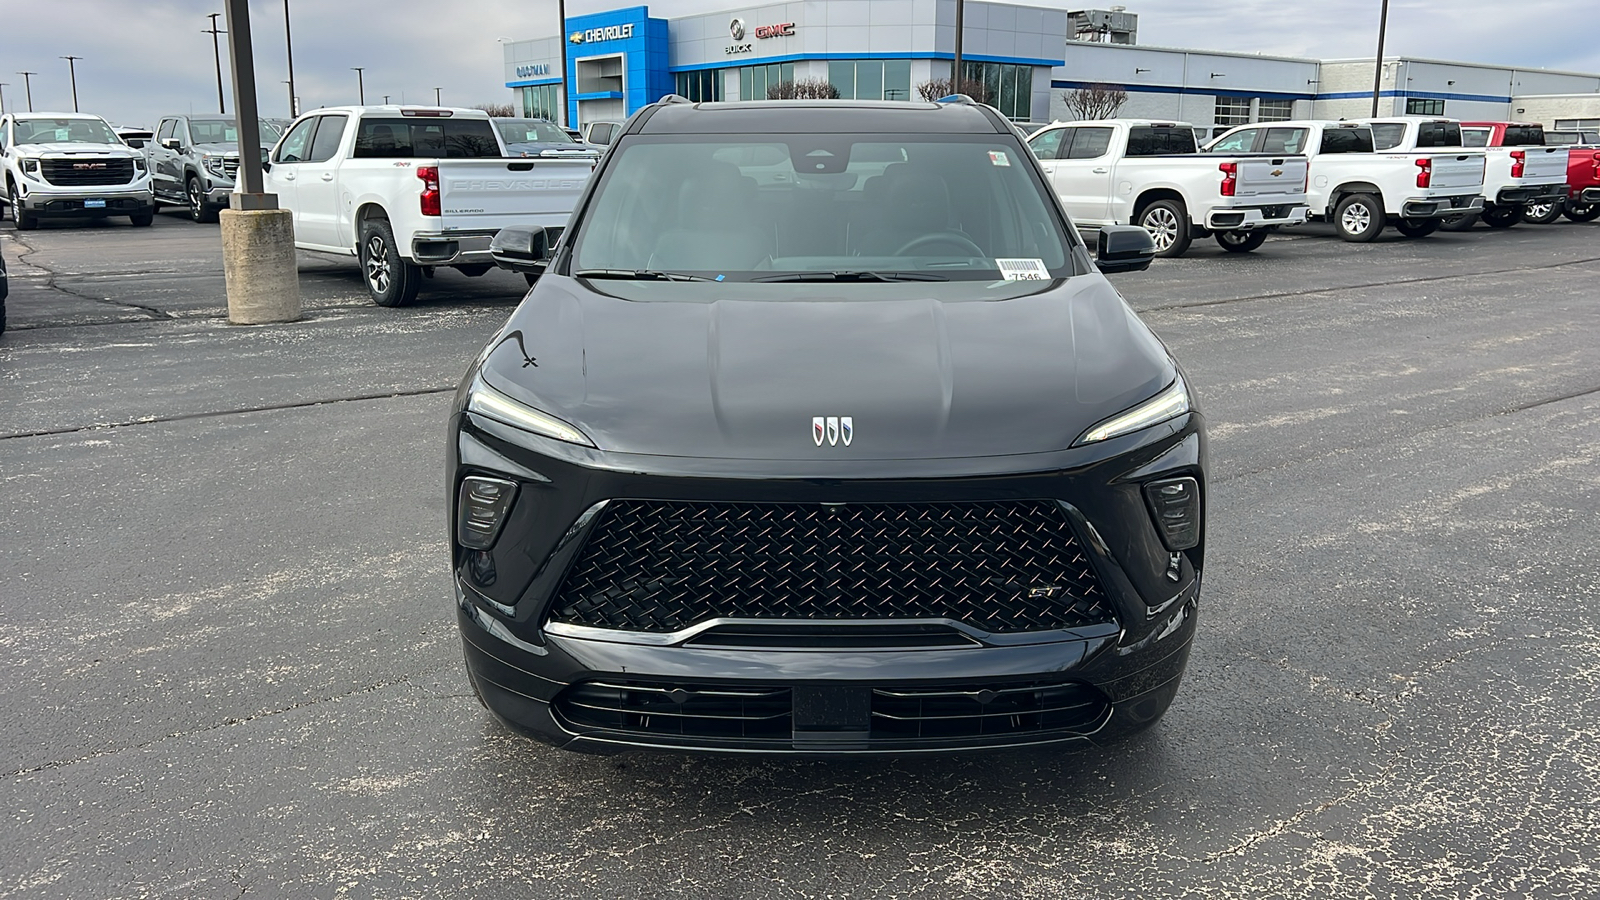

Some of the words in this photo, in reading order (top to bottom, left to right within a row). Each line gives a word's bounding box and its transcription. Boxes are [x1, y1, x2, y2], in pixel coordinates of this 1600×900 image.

[585, 23, 634, 43] CHEVROLET
[755, 23, 795, 39] GMC
[725, 43, 752, 54] BUICK
[452, 179, 586, 191] CHEVROLET
[1012, 273, 1042, 281] 7546
